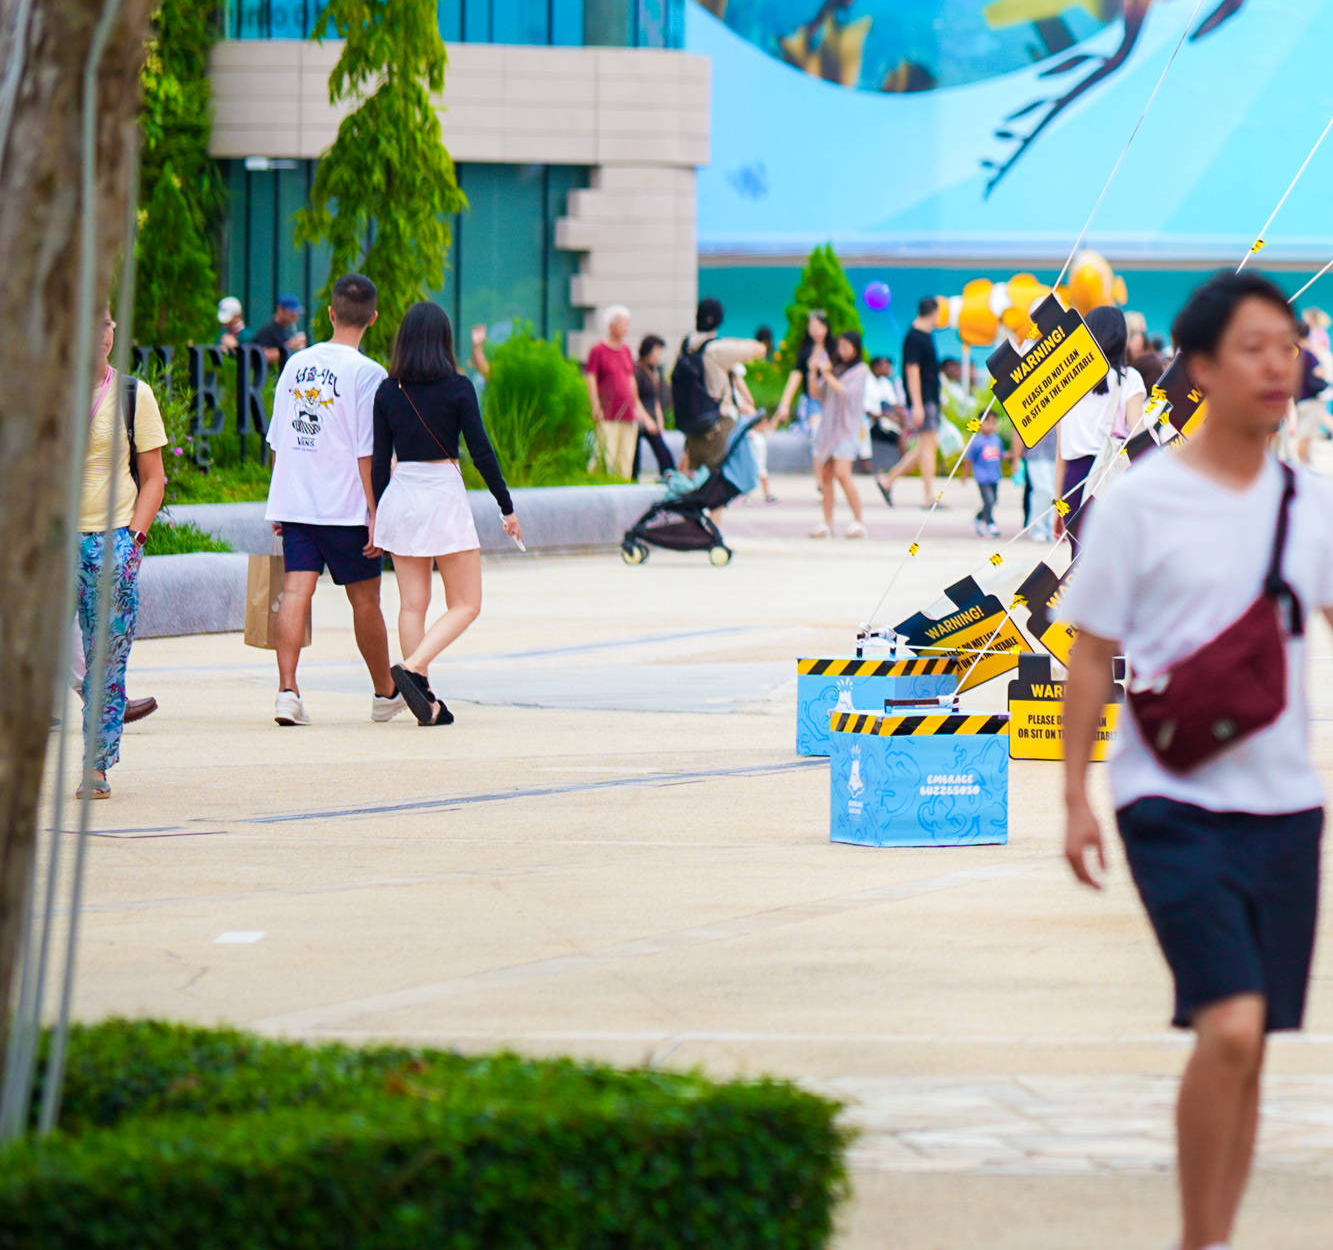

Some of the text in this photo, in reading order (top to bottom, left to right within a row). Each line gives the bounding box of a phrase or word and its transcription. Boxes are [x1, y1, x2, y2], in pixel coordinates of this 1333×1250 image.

[1010, 325, 1067, 385] WARNING!
[1021, 351, 1096, 428] OR SIT ON THE INFLATABLE
[1022, 349, 1080, 410] PLEASE DO NOT LEAN
[925, 605, 985, 641] WARNING!
[970, 636, 985, 647] NOT
[961, 658, 971, 669] ON
[1028, 714, 1055, 725] PLEASE
[1018, 728, 1029, 738] OR
[1031, 729, 1043, 739] SIT
[1045, 729, 1056, 739] ON
